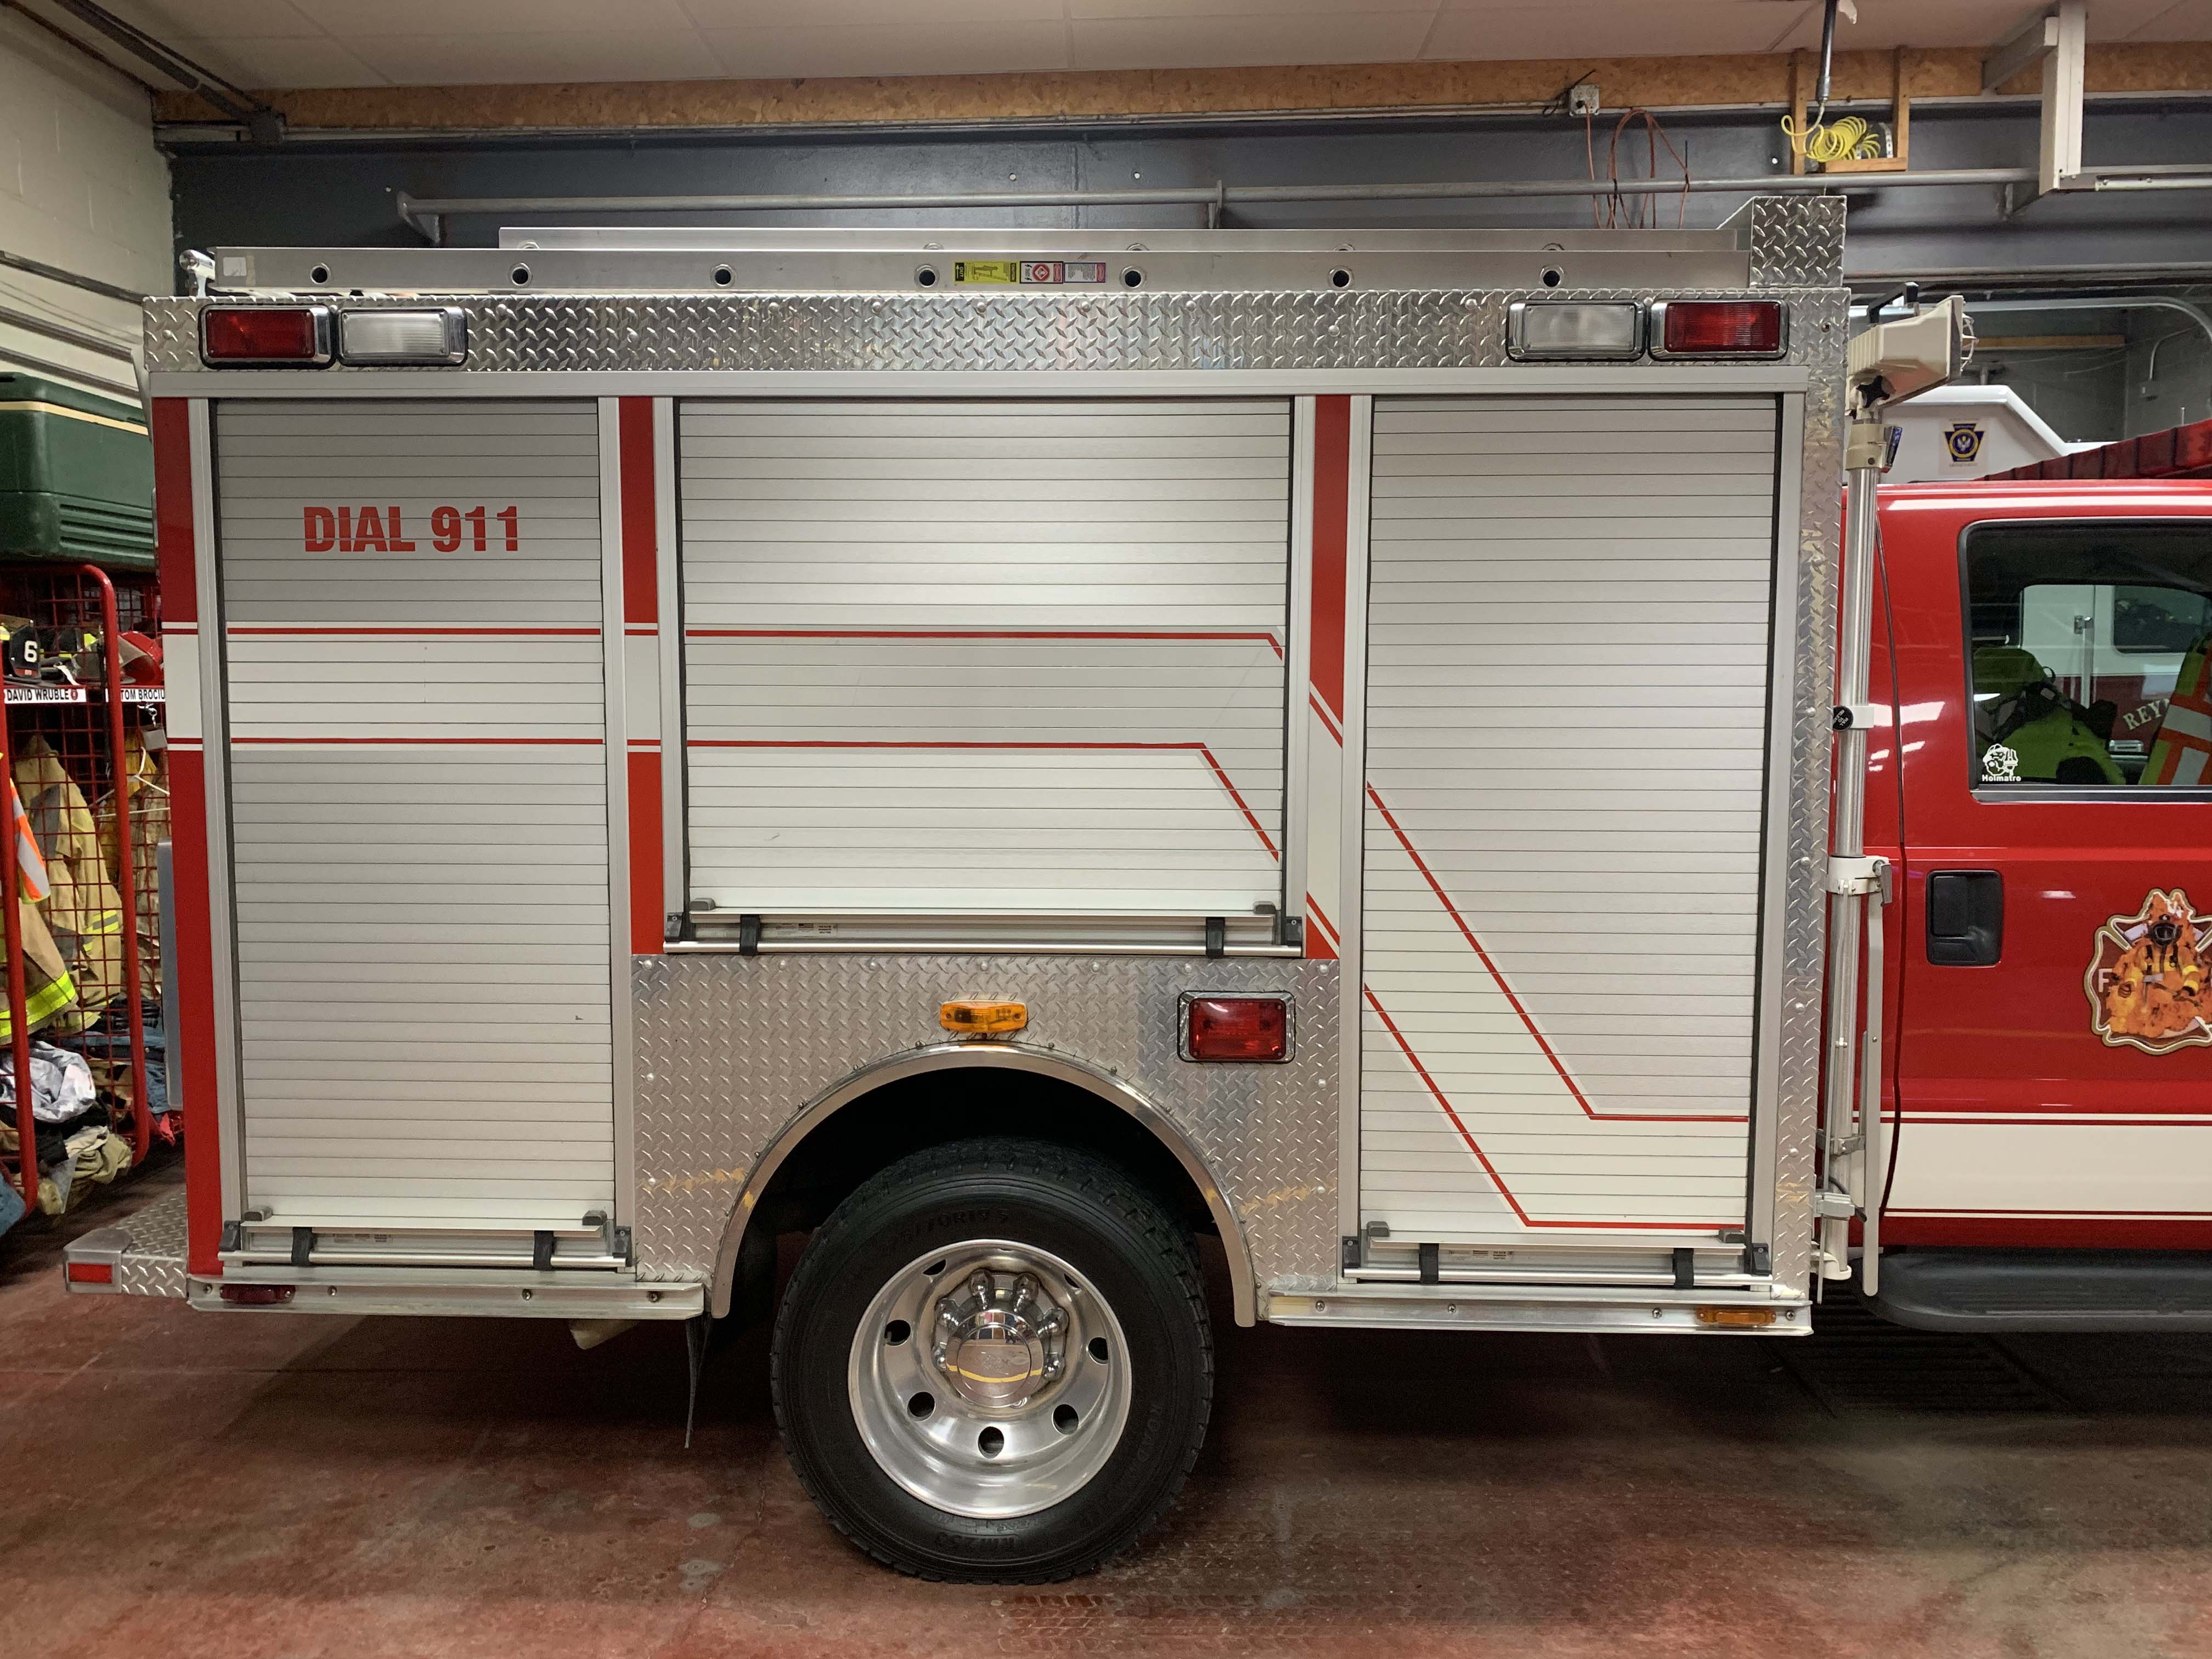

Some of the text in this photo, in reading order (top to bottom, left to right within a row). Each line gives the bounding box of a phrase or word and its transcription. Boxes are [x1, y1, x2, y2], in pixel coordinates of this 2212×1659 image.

[303, 506, 518, 552] DIAL 911
[24, 640, 38, 663] 6
[7, 689, 69, 701] DAVID WRUBLE
[121, 689, 136, 700] TOM
